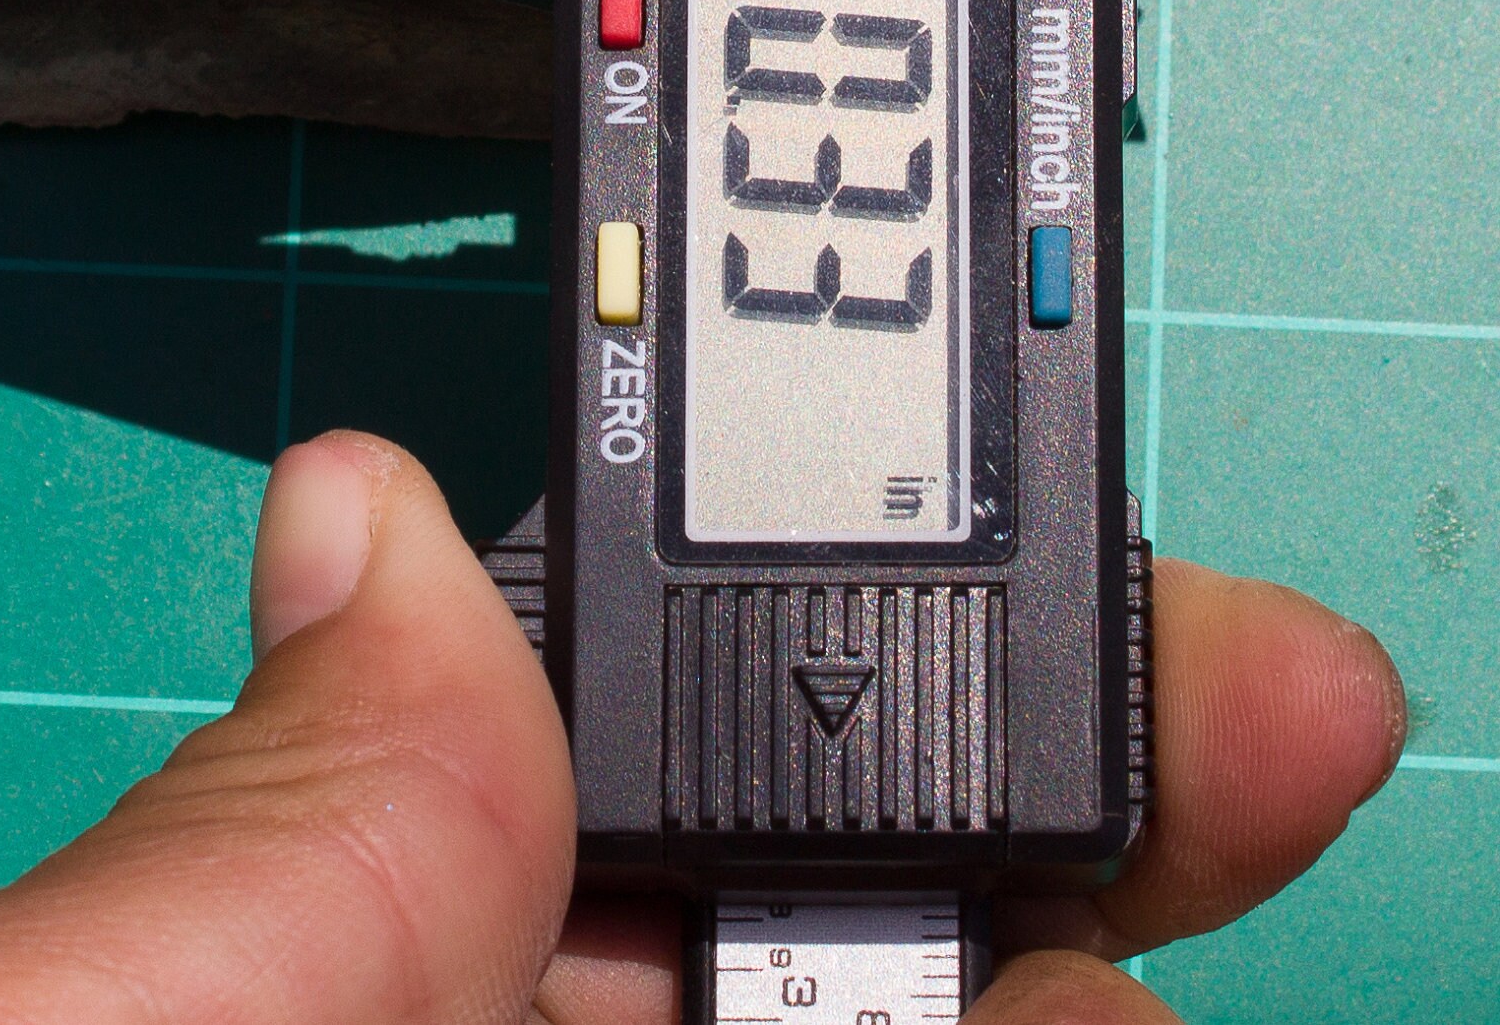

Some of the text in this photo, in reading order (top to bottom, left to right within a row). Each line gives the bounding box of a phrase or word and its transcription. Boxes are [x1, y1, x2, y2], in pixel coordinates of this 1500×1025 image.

[603, 59, 649, 127] ON
[1030, 7, 1072, 211] mm/inch
[722, 5, 932, 331] 0.33
[600, 338, 647, 466] ZERO
[782, 976, 818, 1007] 3
